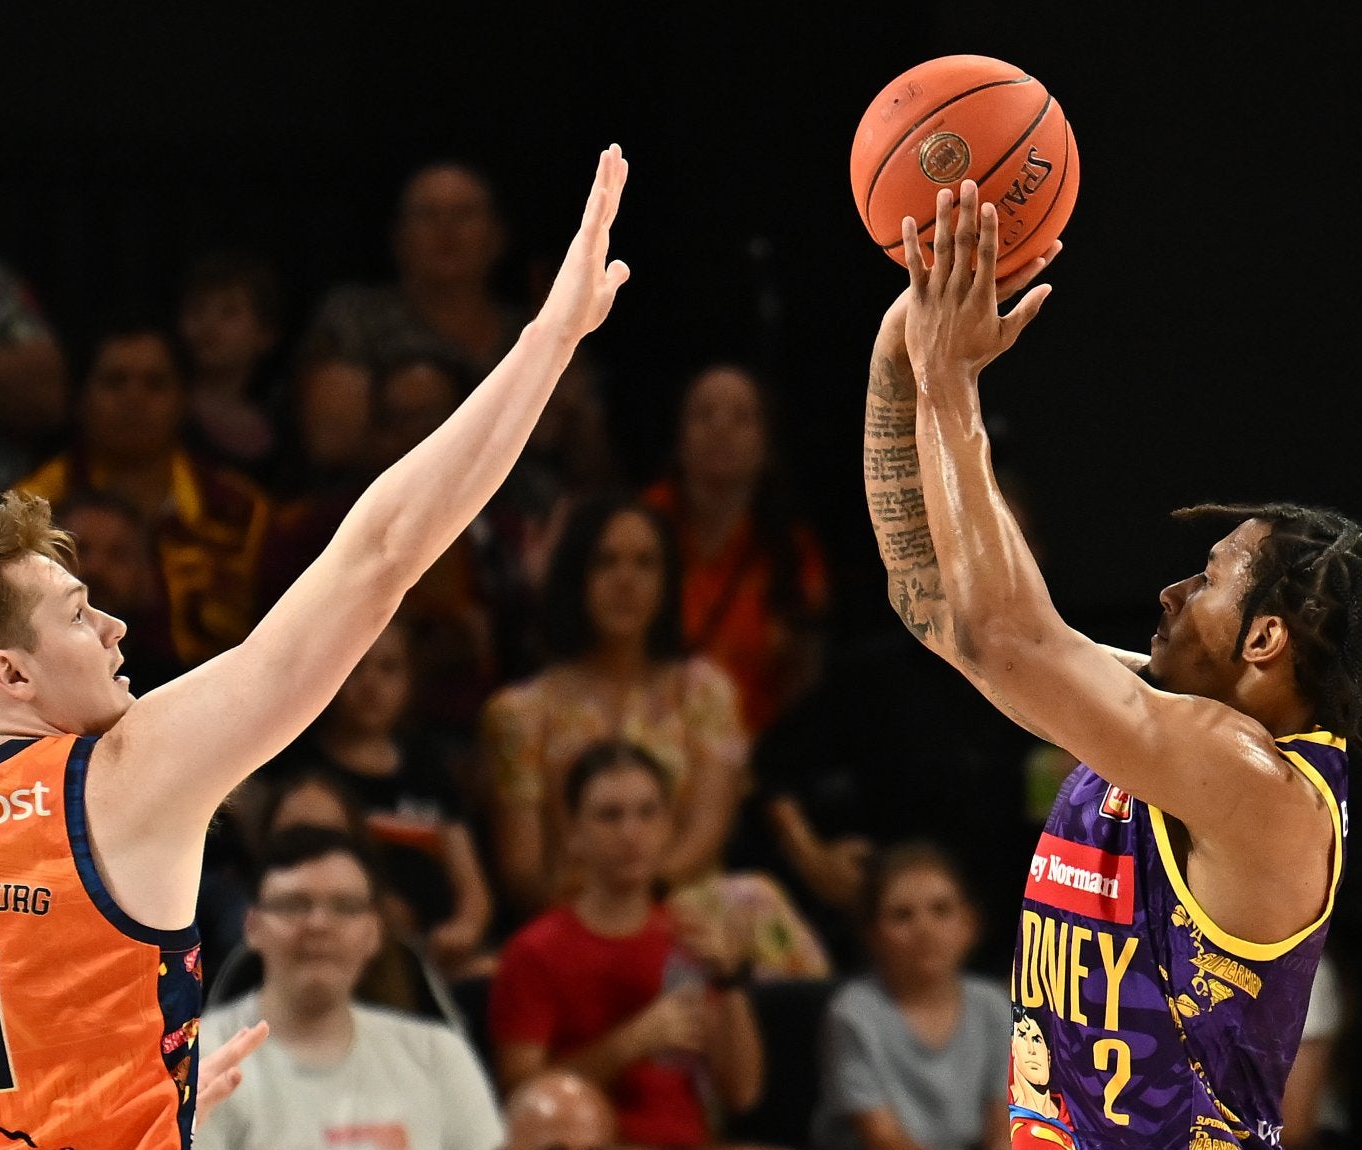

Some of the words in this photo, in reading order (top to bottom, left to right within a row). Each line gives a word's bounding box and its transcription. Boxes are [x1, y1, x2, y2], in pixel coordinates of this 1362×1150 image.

[1050, 854, 1119, 900] Norman
[1012, 909, 1139, 1032] DNEY
[1093, 1038, 1132, 1126] 2
